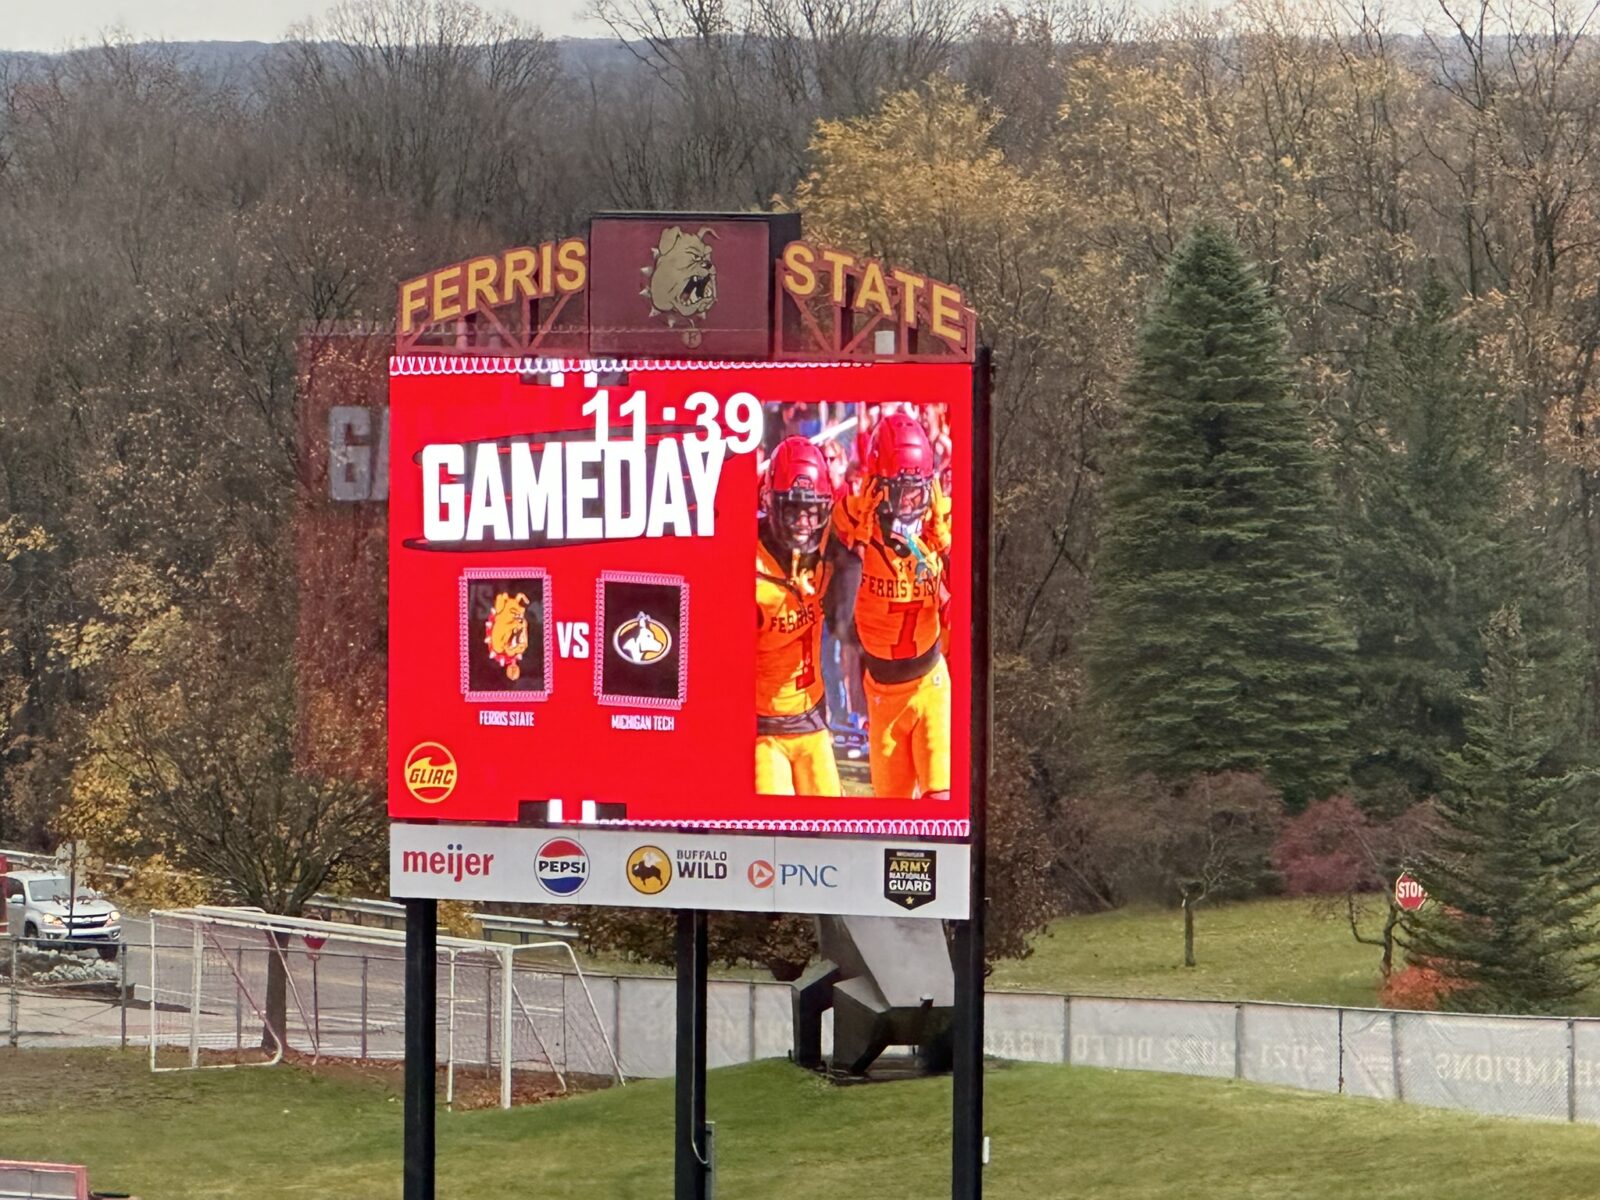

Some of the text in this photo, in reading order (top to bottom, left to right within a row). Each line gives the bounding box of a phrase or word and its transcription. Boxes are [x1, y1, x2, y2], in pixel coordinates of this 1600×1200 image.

[401, 240, 963, 342] FERRIS STATE
[582, 389, 764, 454] 11:39
[422, 436, 728, 542] GAMEDAY
[556, 621, 590, 659] VS
[479, 710, 535, 726] FERRIS STATE
[611, 714, 675, 731] MICHIGAN TECH
[409, 768, 455, 785] GLIAC
[402, 843, 495, 882] meijer
[676, 849, 728, 861] BUFFALO
[538, 860, 586, 874] PEPSI
[677, 861, 728, 880] WILD
[889, 860, 930, 872] ARMY
[779, 863, 838, 889] PNC
[889, 872, 931, 880] NATIONAL
[889, 880, 932, 892] GUARD
